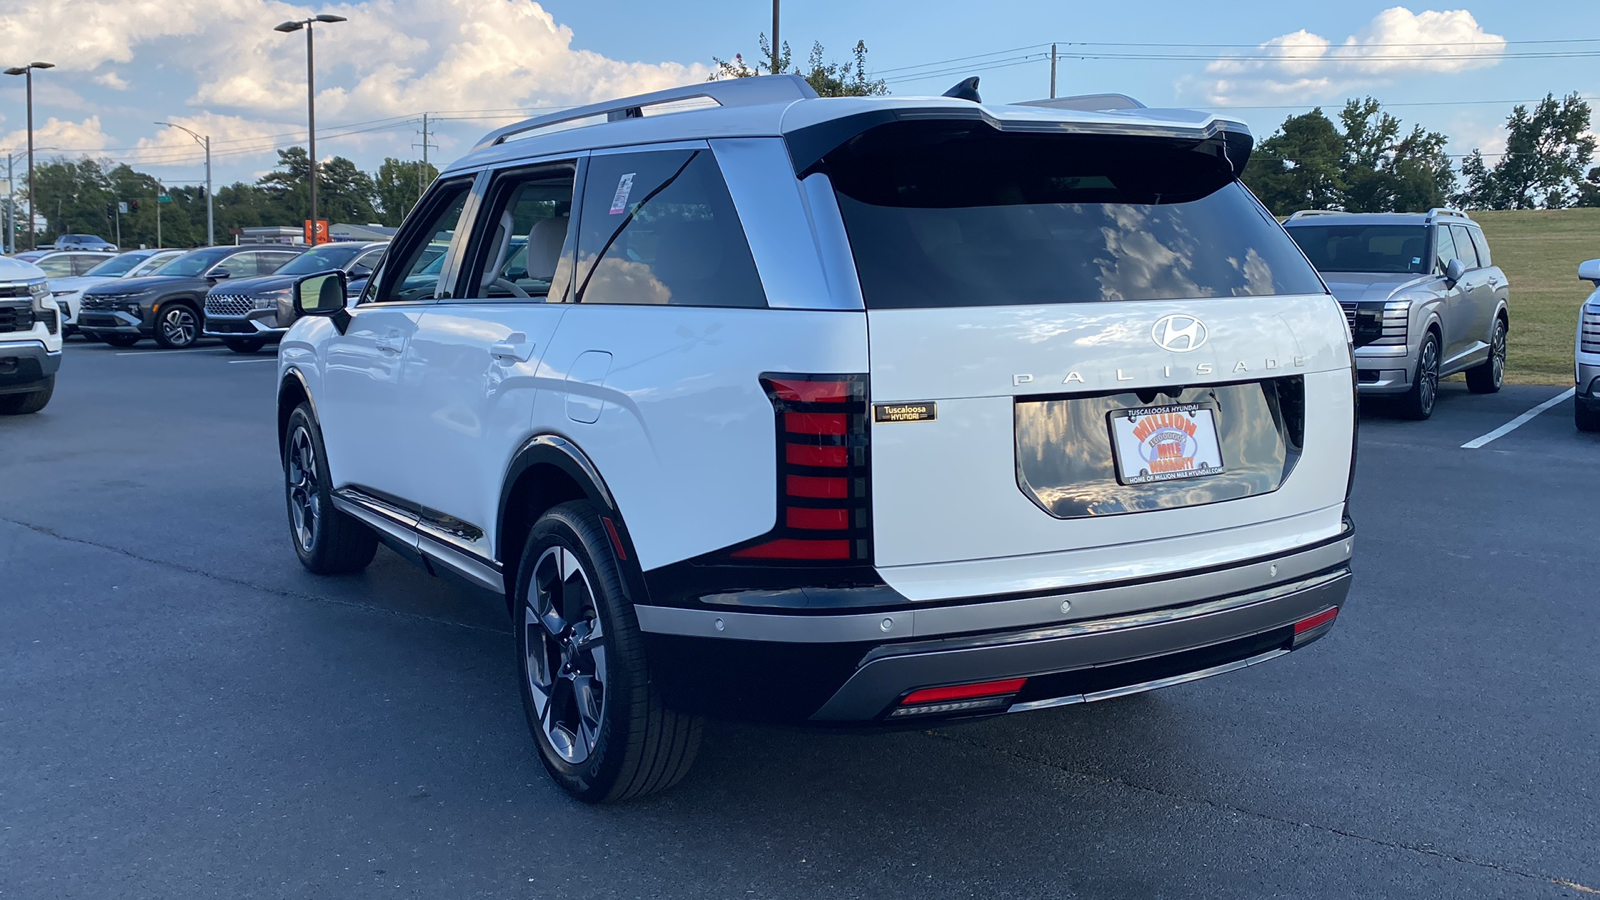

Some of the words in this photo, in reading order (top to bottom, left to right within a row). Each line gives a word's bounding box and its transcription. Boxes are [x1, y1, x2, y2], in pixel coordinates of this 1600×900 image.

[1012, 356, 1305, 387] PALISADE
[884, 405, 926, 414] Tuscaloosa
[1128, 407, 1170, 416] TUSCALOOSA
[1171, 404, 1199, 412] HYUNDAI
[1133, 413, 1197, 442] MILLION
[1157, 442, 1182, 458] MILE
